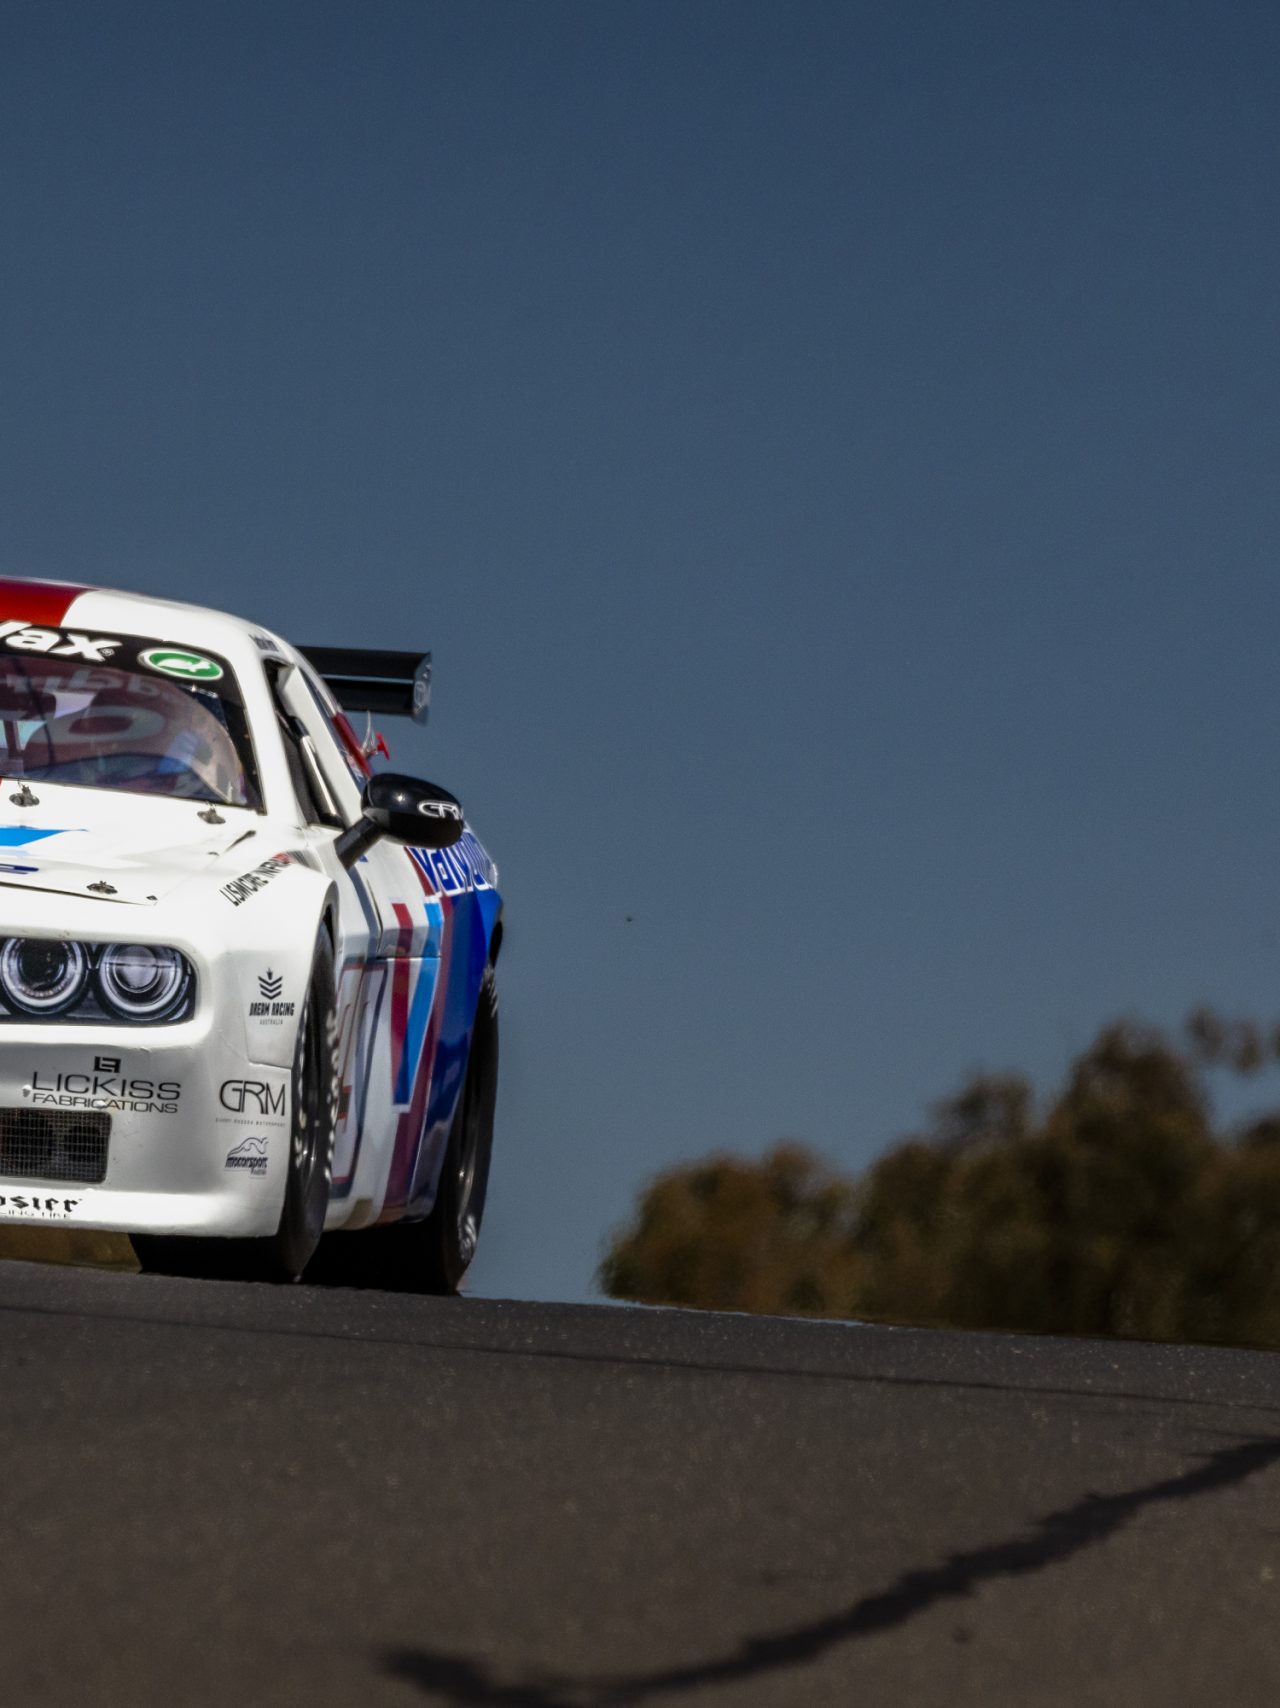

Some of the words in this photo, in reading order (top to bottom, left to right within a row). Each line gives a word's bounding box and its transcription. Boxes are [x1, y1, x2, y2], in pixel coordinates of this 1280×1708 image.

[249, 1002, 270, 1016] DREAM
[271, 1002, 295, 1016] RACING
[32, 1071, 181, 1100] LICKISS
[220, 1080, 285, 1116] GRM
[32, 1093, 178, 1114] FABRICATIONS
